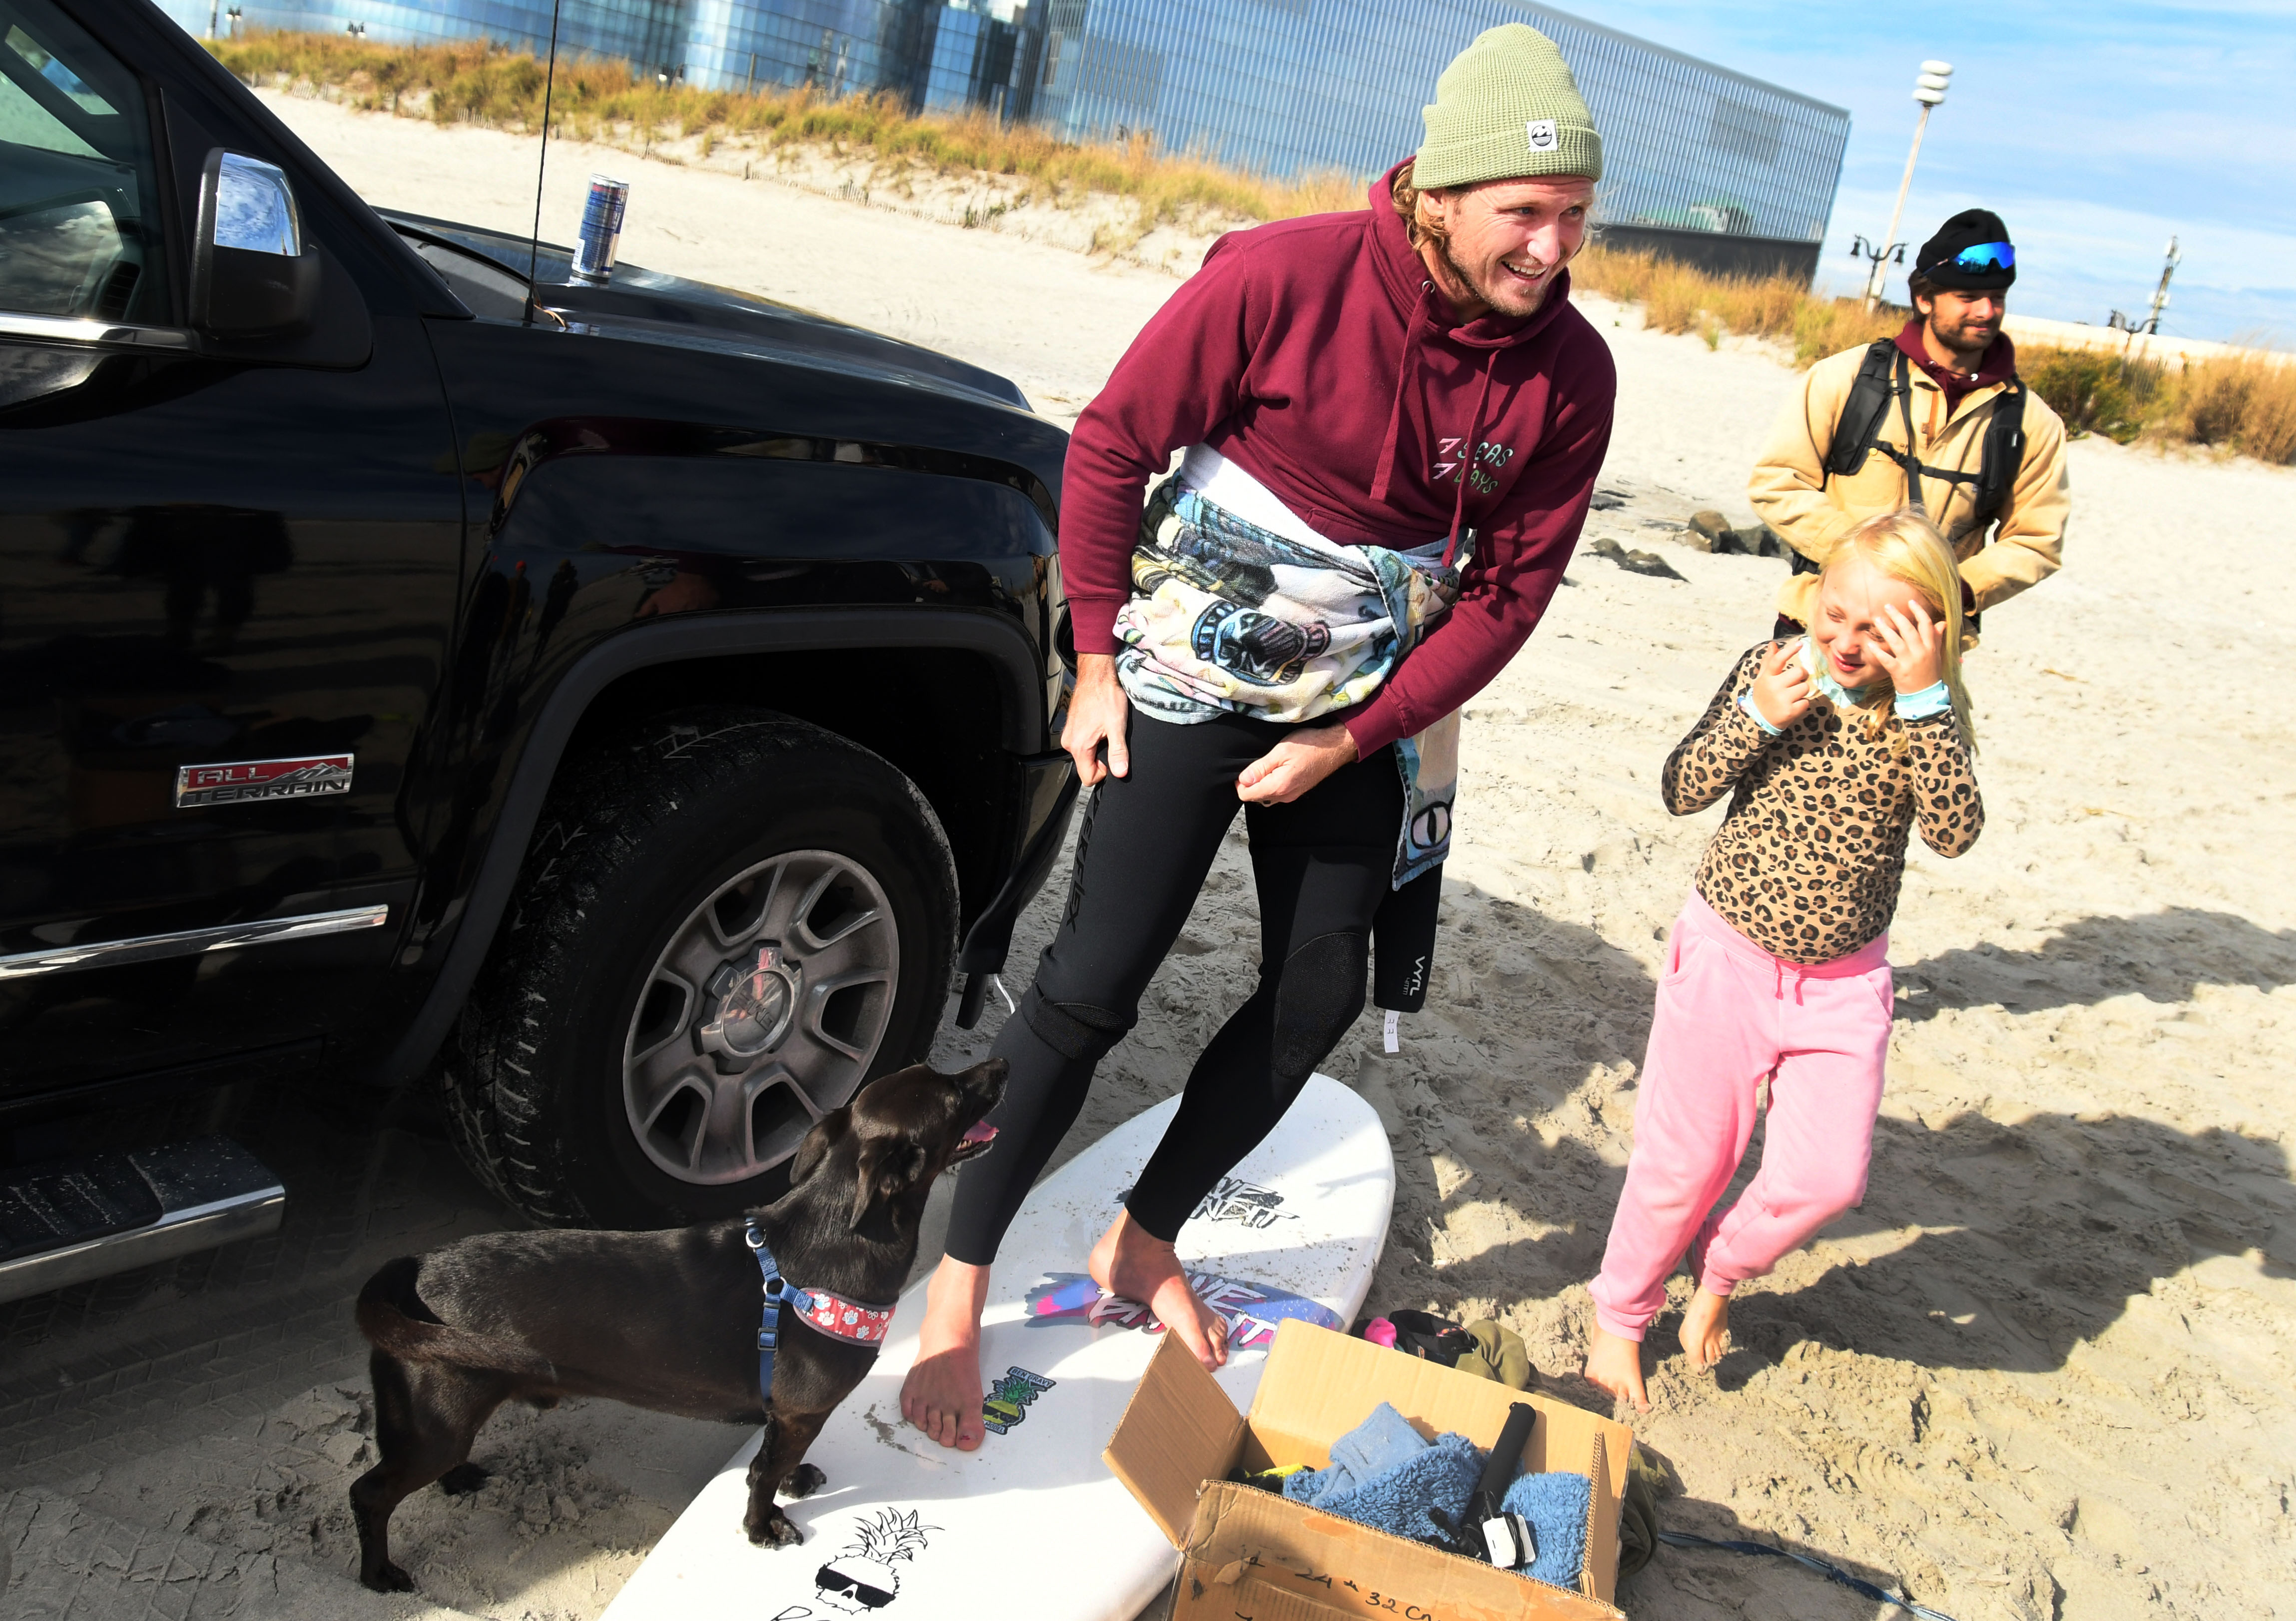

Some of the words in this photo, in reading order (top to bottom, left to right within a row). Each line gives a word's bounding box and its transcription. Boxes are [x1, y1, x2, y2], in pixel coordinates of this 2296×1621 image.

[197, 767, 269, 785] ALL
[185, 779, 346, 803] TERRAIN
[1011, 1368, 1027, 1378] BEN
[1027, 1374, 1053, 1387] GRAVY
[1365, 1592, 1399, 1614] 32
